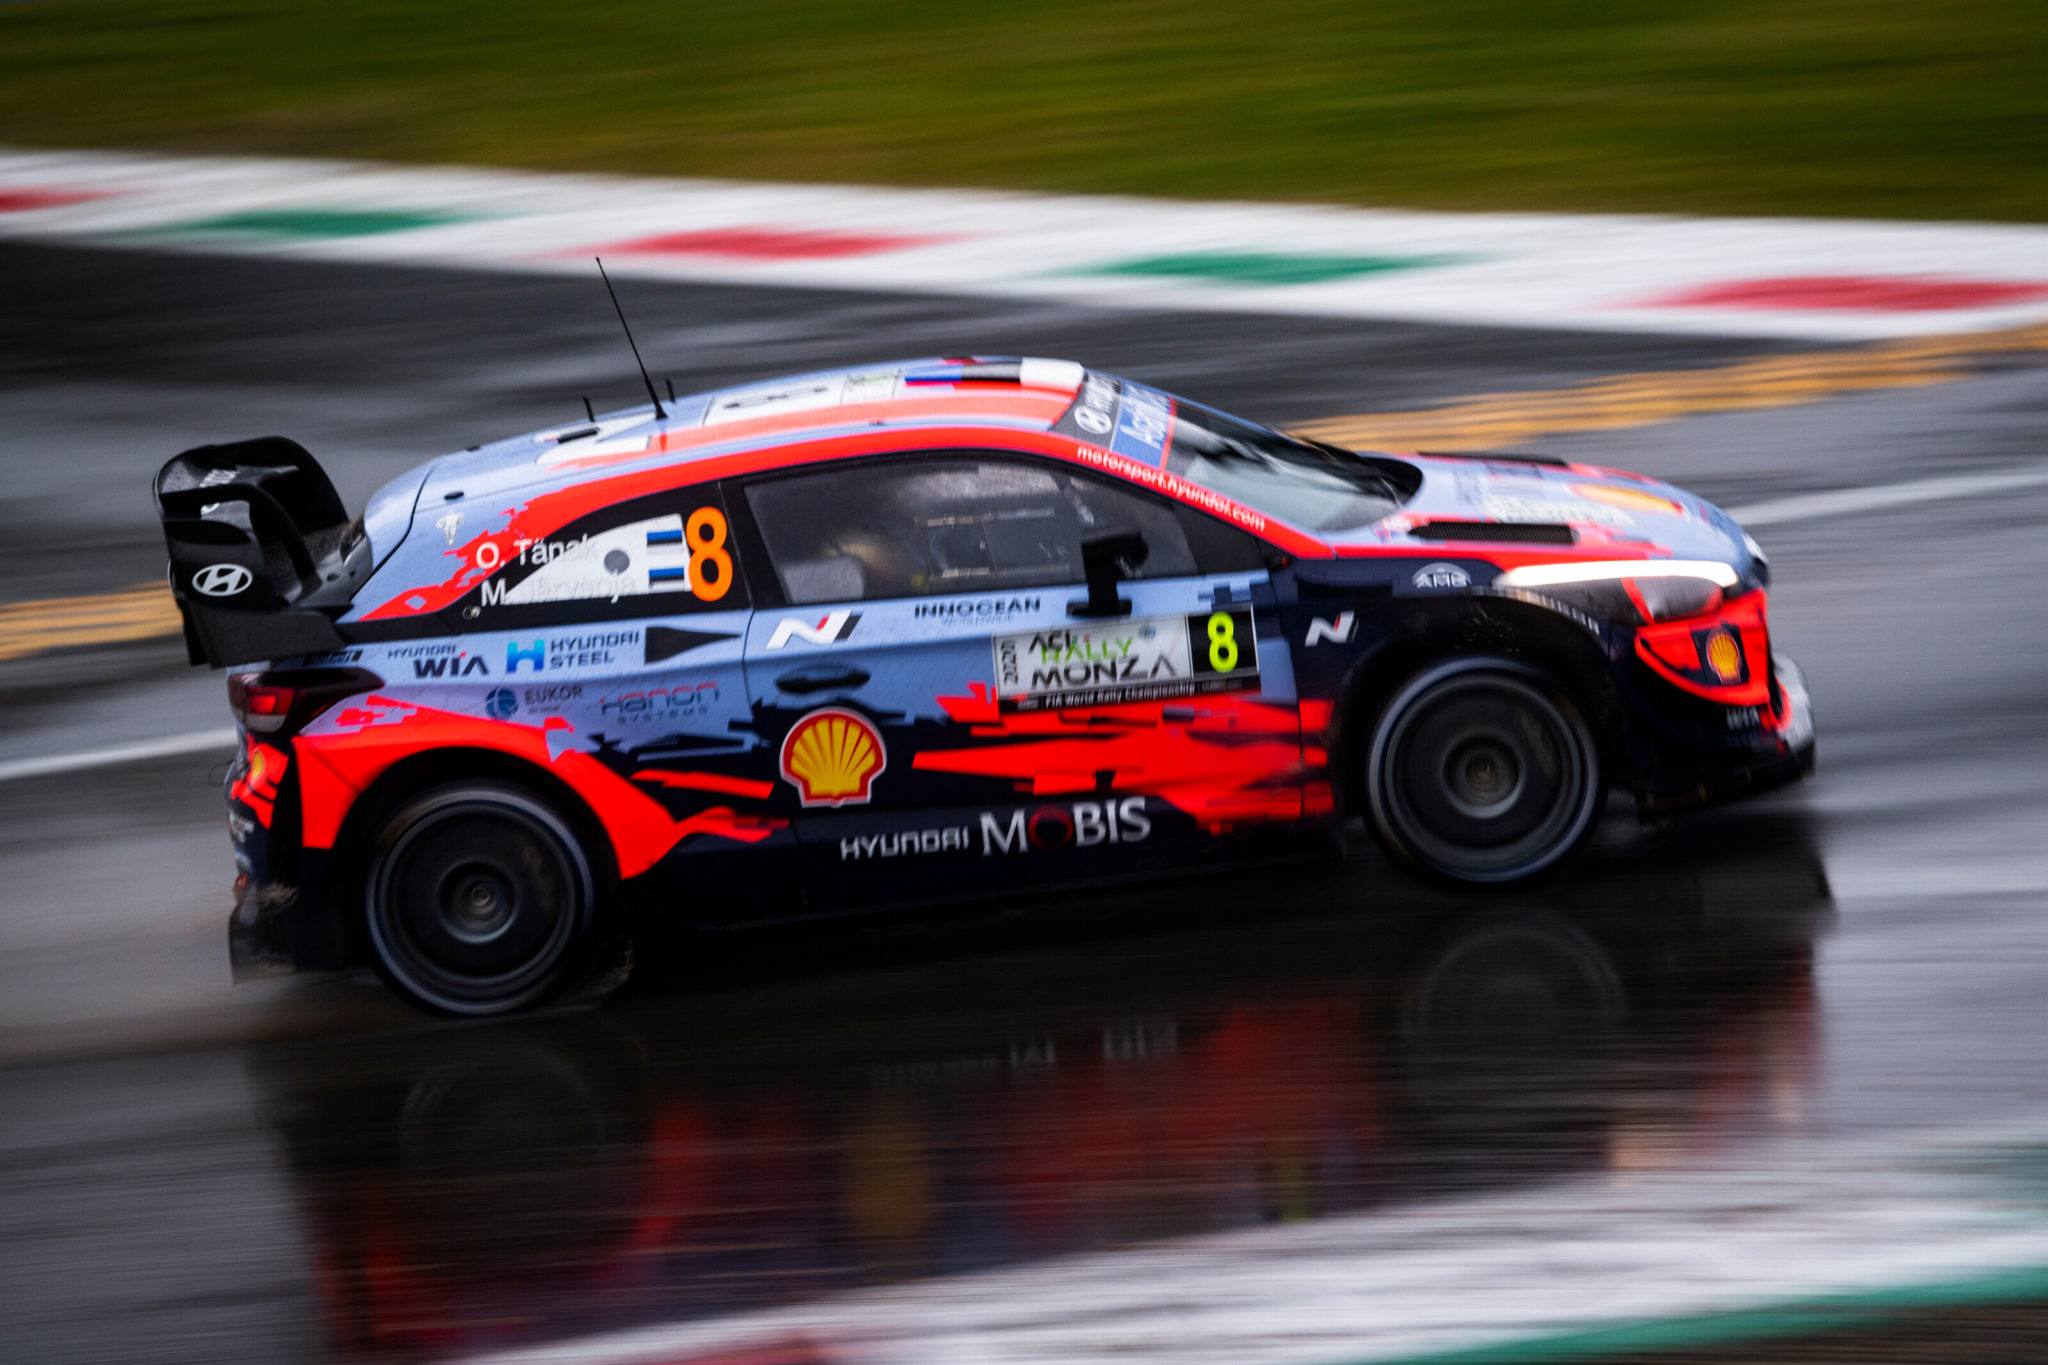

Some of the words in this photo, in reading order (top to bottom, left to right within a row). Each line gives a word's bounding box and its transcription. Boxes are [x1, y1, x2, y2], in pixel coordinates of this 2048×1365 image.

[475, 541, 506, 570] O.
[686, 506, 734, 602] 8
[914, 597, 1040, 619] INNOCEAN
[387, 643, 457, 660] HYUNDAI
[550, 632, 640, 654] HYUNDAI
[1041, 634, 1134, 665] RALLY
[1207, 611, 1239, 673] 8
[550, 649, 616, 670] STEEL
[1031, 653, 1178, 691] MONZA
[525, 683, 583, 705] EUKOR
[1097, 689, 1122, 704] Rally
[616, 704, 711, 725] SYSTEMS
[979, 795, 1152, 857] MOBIS
[839, 826, 970, 861] HYUNDAI
